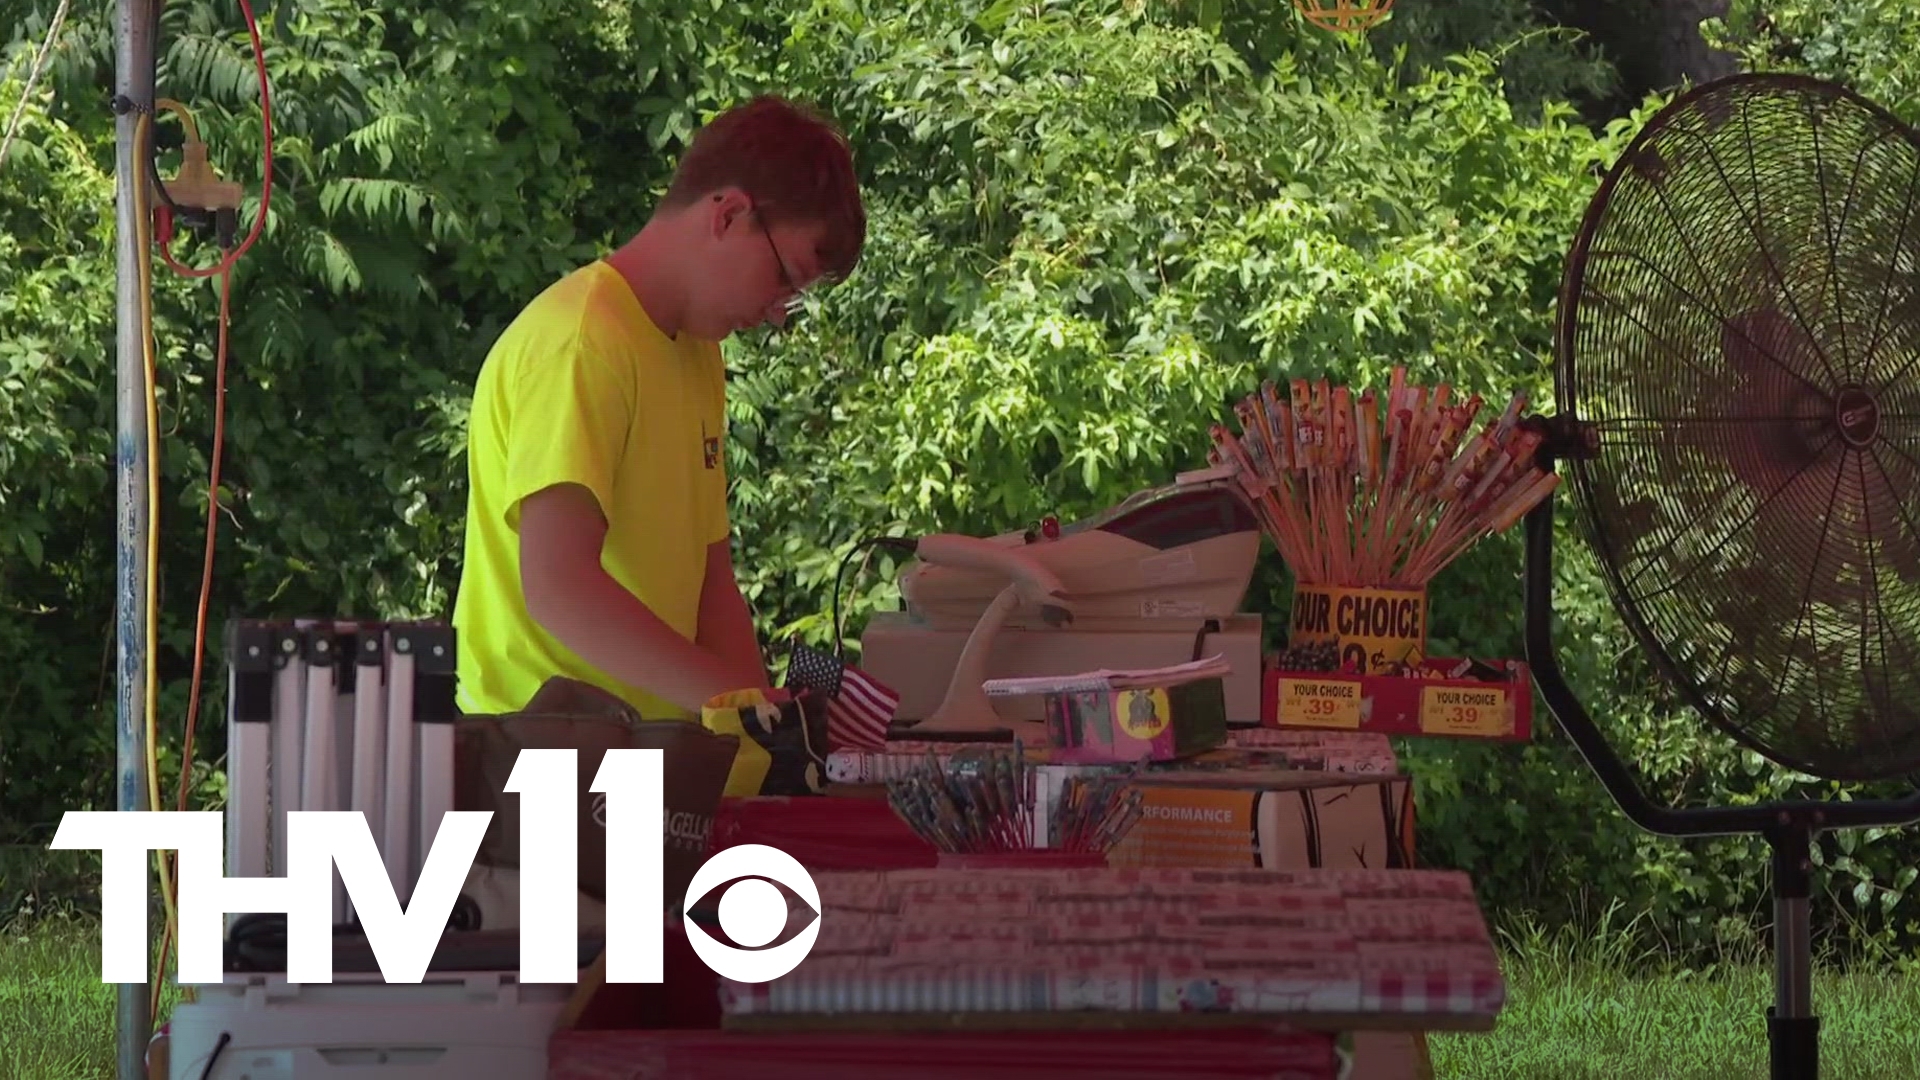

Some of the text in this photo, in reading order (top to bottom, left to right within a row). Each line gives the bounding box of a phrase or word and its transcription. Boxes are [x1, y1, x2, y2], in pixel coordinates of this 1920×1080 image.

[1337, 595, 1420, 639] CHOICE
[1293, 684, 1353, 698] YOUR CHOICE
[1437, 692, 1496, 706] YOUR CHOICE
